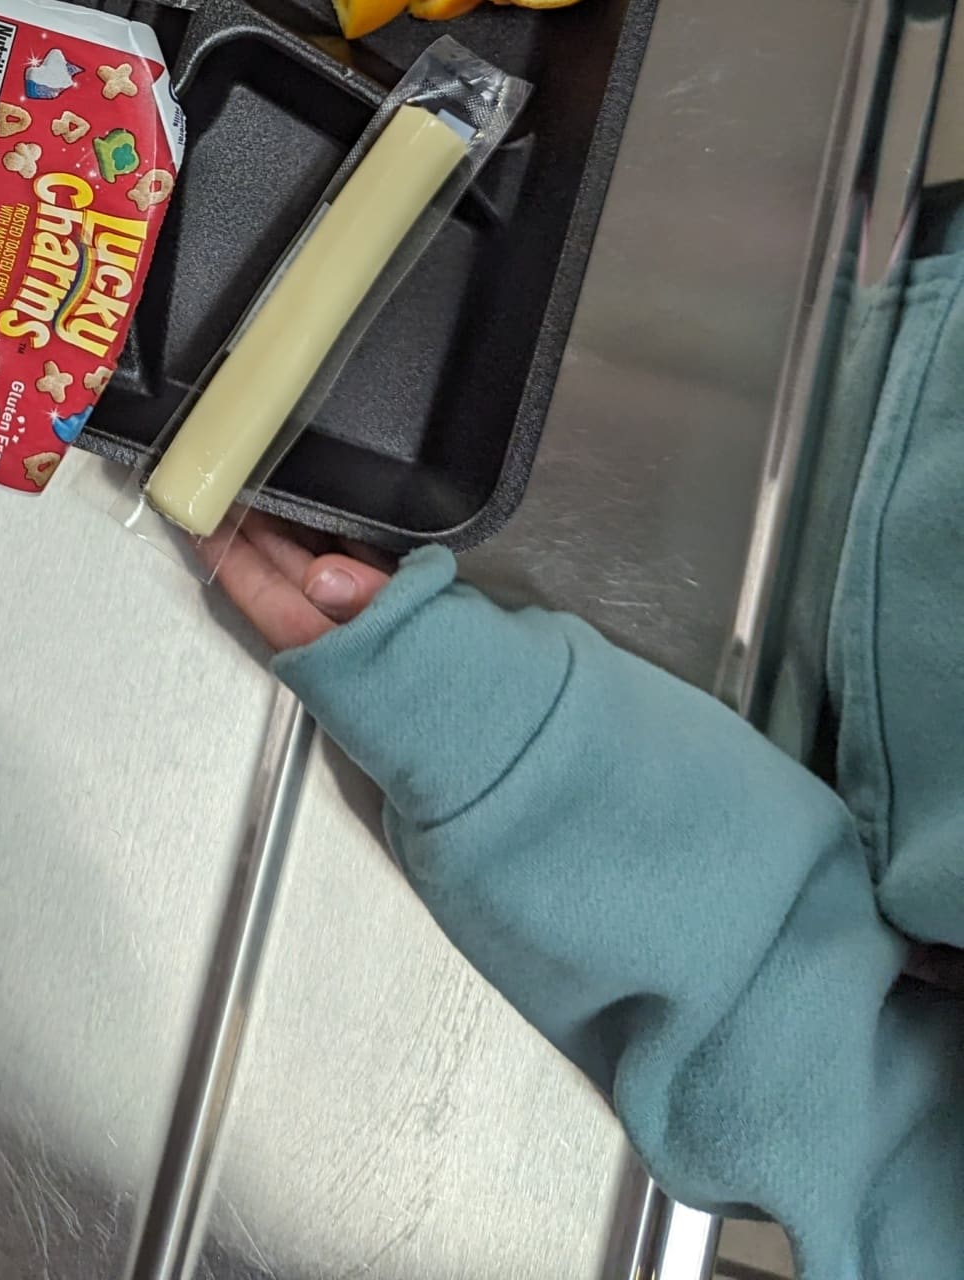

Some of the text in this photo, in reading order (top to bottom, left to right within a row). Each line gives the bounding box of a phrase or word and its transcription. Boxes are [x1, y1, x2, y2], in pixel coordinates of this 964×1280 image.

[8, 203, 29, 237] FROSTED
[53, 209, 149, 358] Lucky
[0, 380, 24, 432] Gluten
